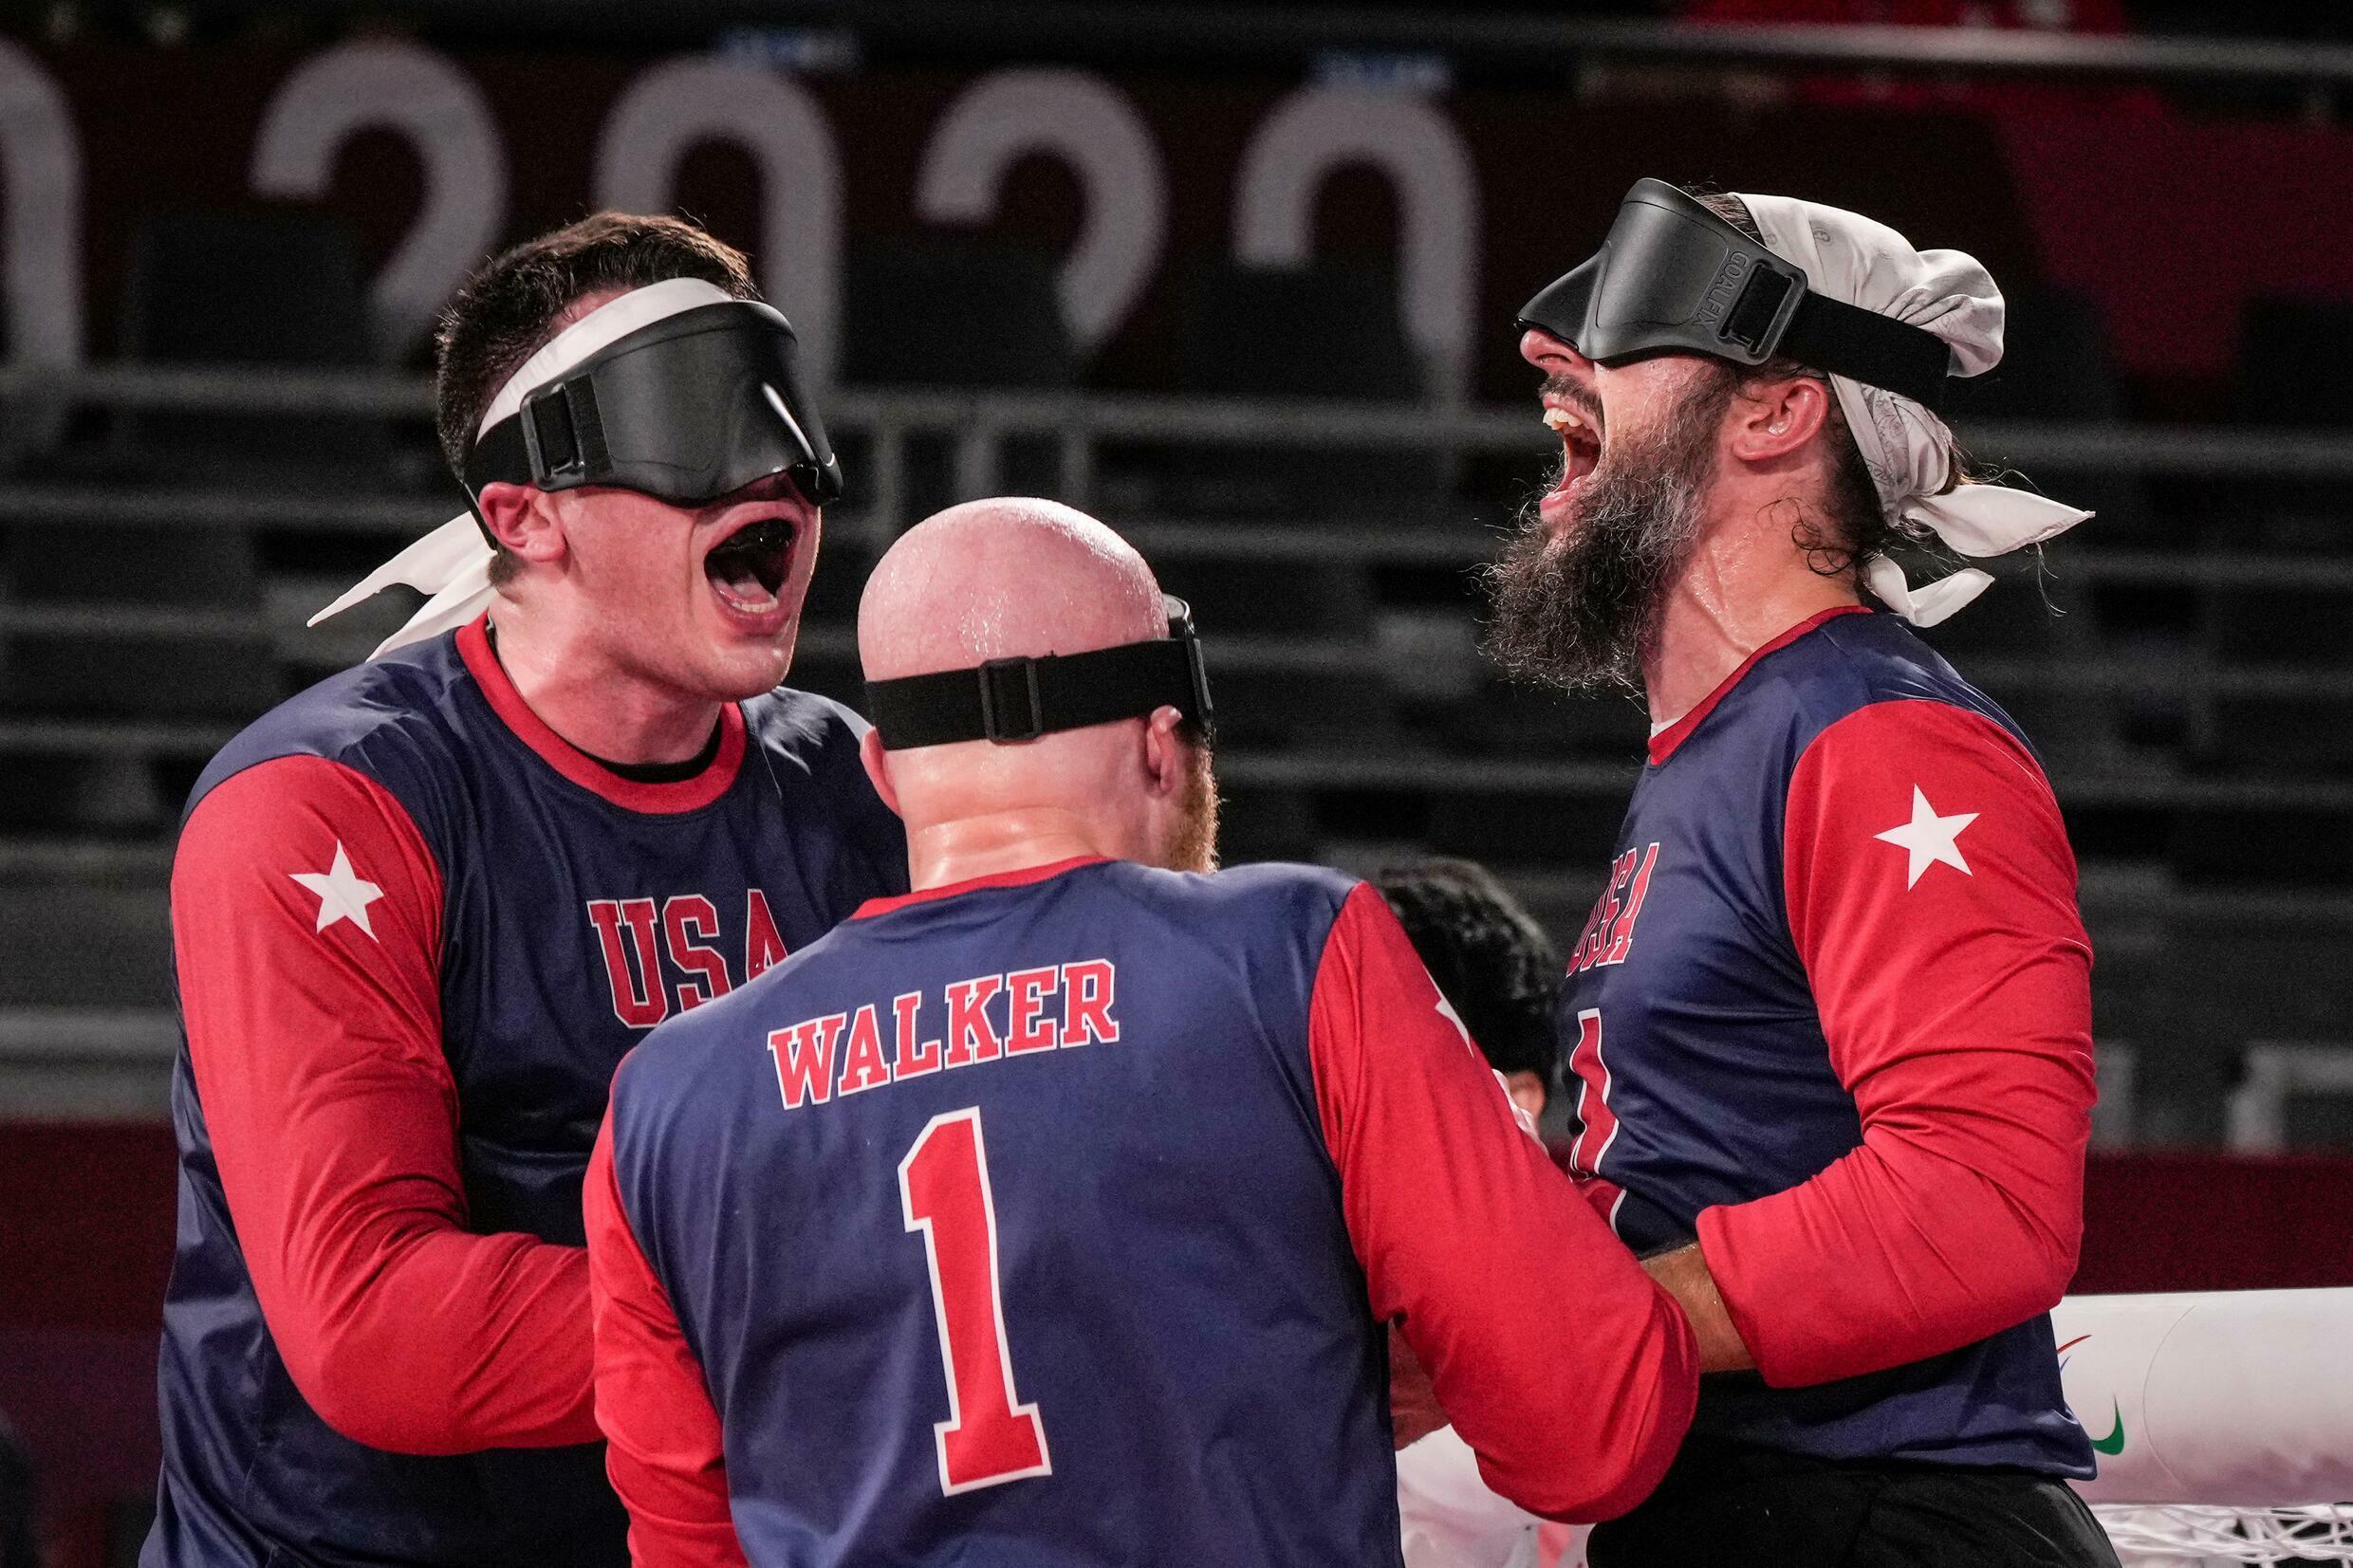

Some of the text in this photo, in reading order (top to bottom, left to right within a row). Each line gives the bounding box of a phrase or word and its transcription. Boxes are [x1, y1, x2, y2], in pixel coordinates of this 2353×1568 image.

[1691, 249, 1751, 327] GOALFIX
[767, 958, 1120, 1110] WALKER
[897, 1105, 1053, 1498] 1
